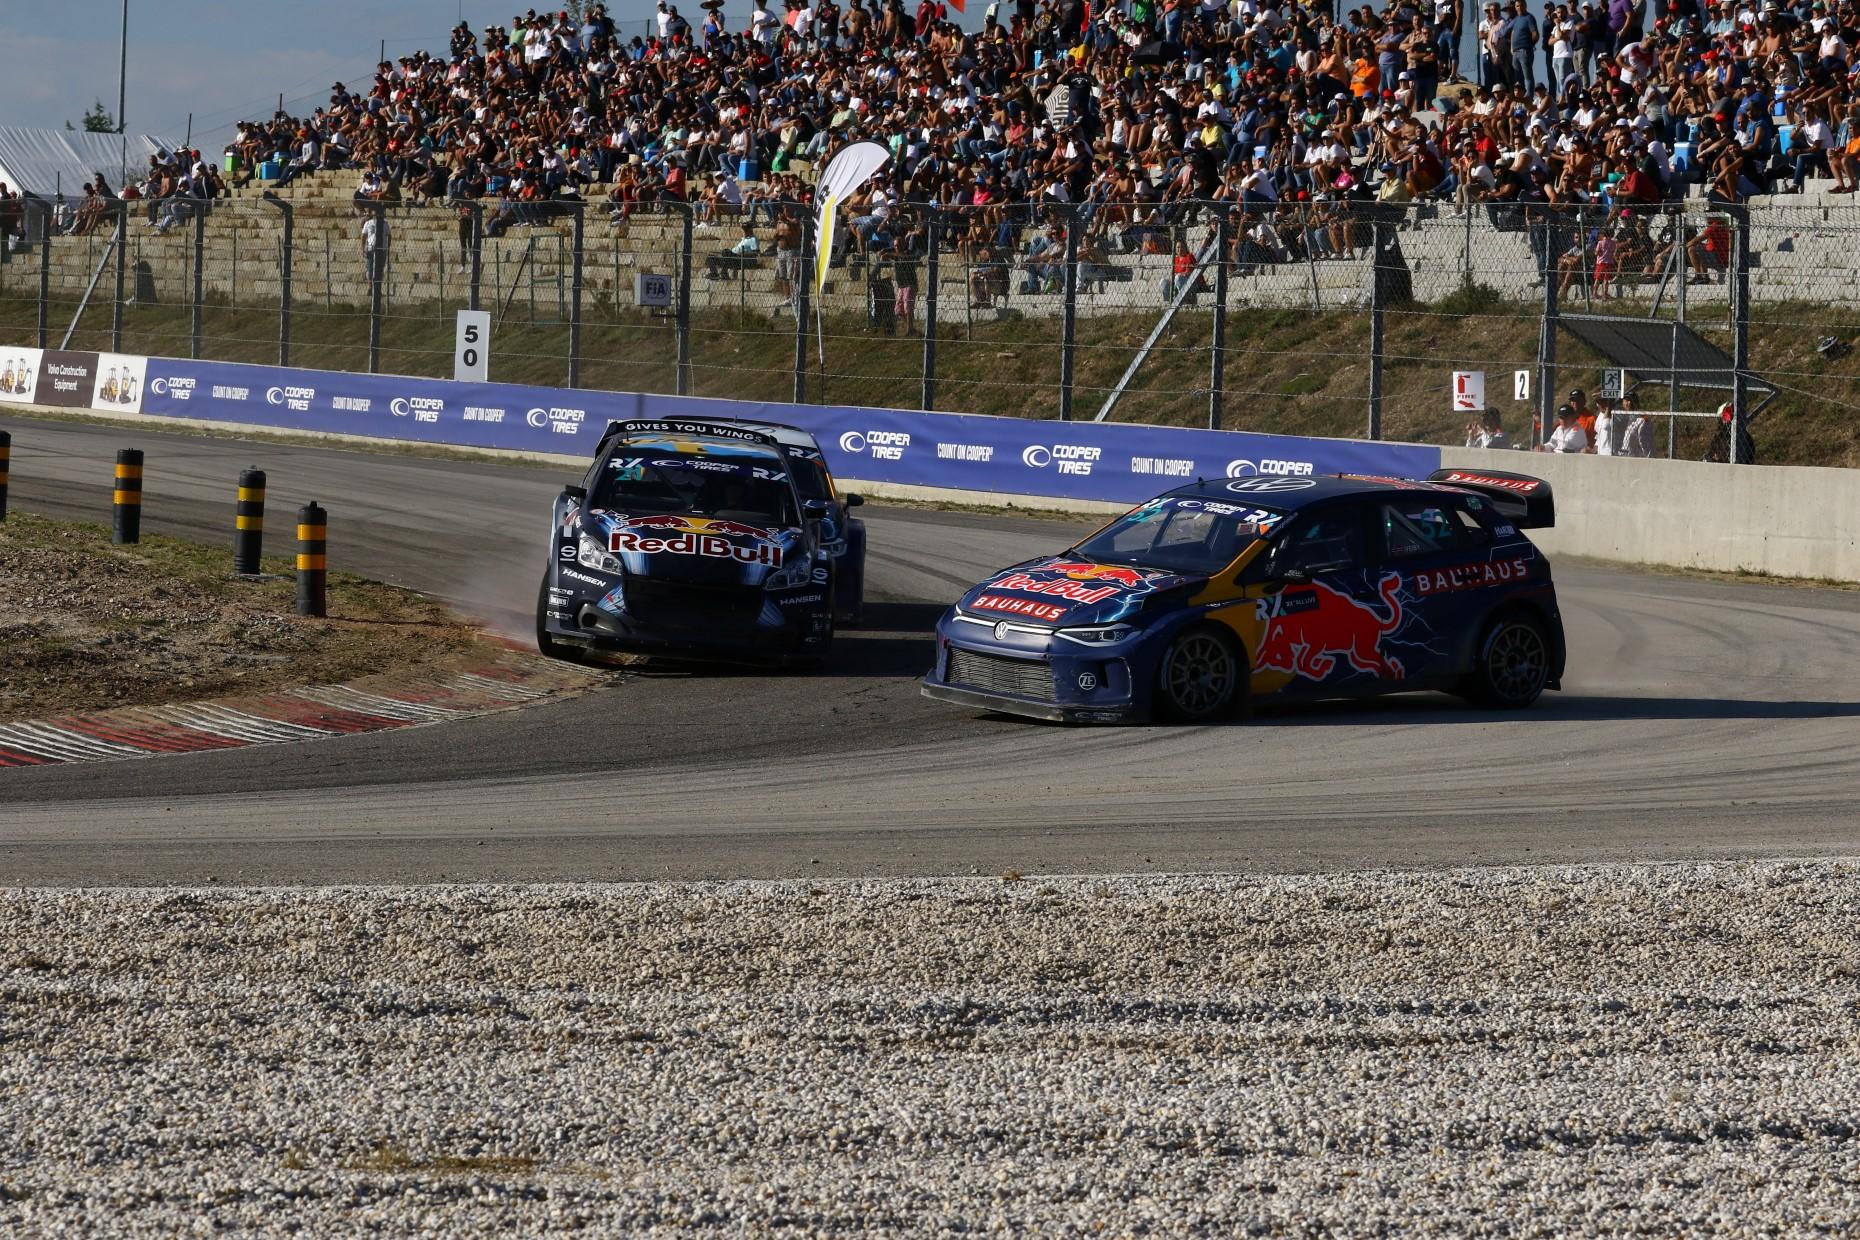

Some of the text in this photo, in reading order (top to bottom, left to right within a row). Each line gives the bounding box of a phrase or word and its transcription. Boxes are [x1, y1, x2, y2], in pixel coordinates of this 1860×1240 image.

[47, 363, 88, 377] Volvo Construction
[54, 378, 78, 392] Equipment
[168, 377, 195, 389] COOPER
[1519, 373, 1526, 398] 2
[171, 388, 191, 399] TIRES
[284, 386, 315, 399] COOPER
[1602, 390, 1620, 398] EXIT
[287, 399, 309, 411] TIRES
[410, 397, 444, 411] COOPER
[414, 410, 439, 422] TIRES
[549, 407, 585, 421] COOPER
[552, 422, 579, 434] TIRES
[625, 423, 762, 443] GIVES YOU WINGS
[866, 430, 910, 446] COOPER
[872, 446, 904, 460] TIRES
[937, 442, 957, 459] COUNT
[957, 444, 966, 460] ON
[1052, 444, 1101, 460] COOPER
[608, 457, 645, 469] RX
[685, 460, 740, 470] COOPER
[693, 464, 731, 472] TIRES
[1057, 460, 1092, 475] TIRES
[1131, 456, 1153, 474] COUNT
[1154, 458, 1164, 474] ON
[1259, 459, 1314, 476] COOPER
[752, 466, 788, 481] RX
[1446, 473, 1540, 492] BAUHAUS
[1203, 502, 1247, 513] COOPER
[1203, 506, 1237, 515] TIRES
[1244, 509, 1283, 526] RX
[608, 531, 784, 568] Red Bull
[562, 568, 607, 588] HANSEN
[988, 573, 1122, 605] Red Bull
[780, 594, 822, 605] HANSEN
[974, 597, 1067, 619] BAUHAUS
